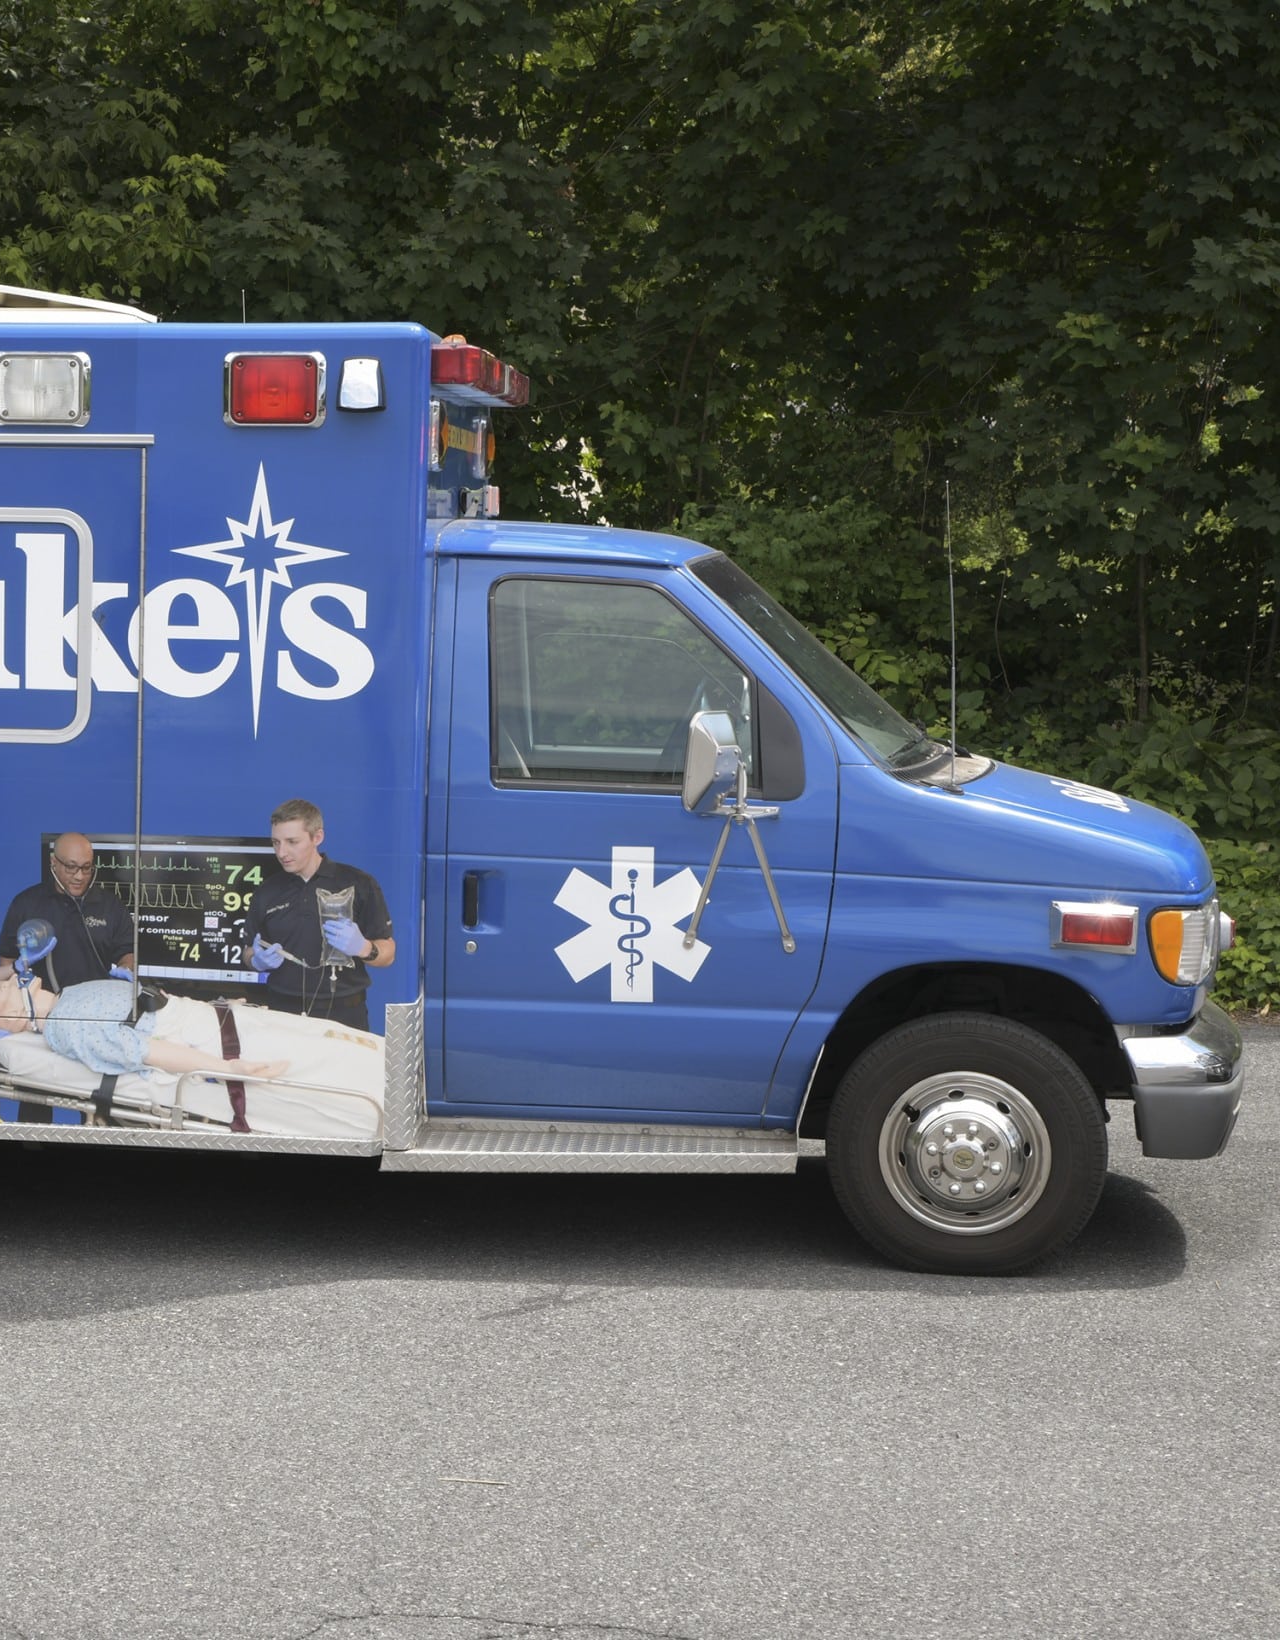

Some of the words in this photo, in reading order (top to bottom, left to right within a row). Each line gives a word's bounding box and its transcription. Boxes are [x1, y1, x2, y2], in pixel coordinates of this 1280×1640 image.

[224, 865, 263, 885] 74
[146, 927, 197, 936] connected
[180, 943, 200, 961] 74
[221, 945, 241, 963] 12
